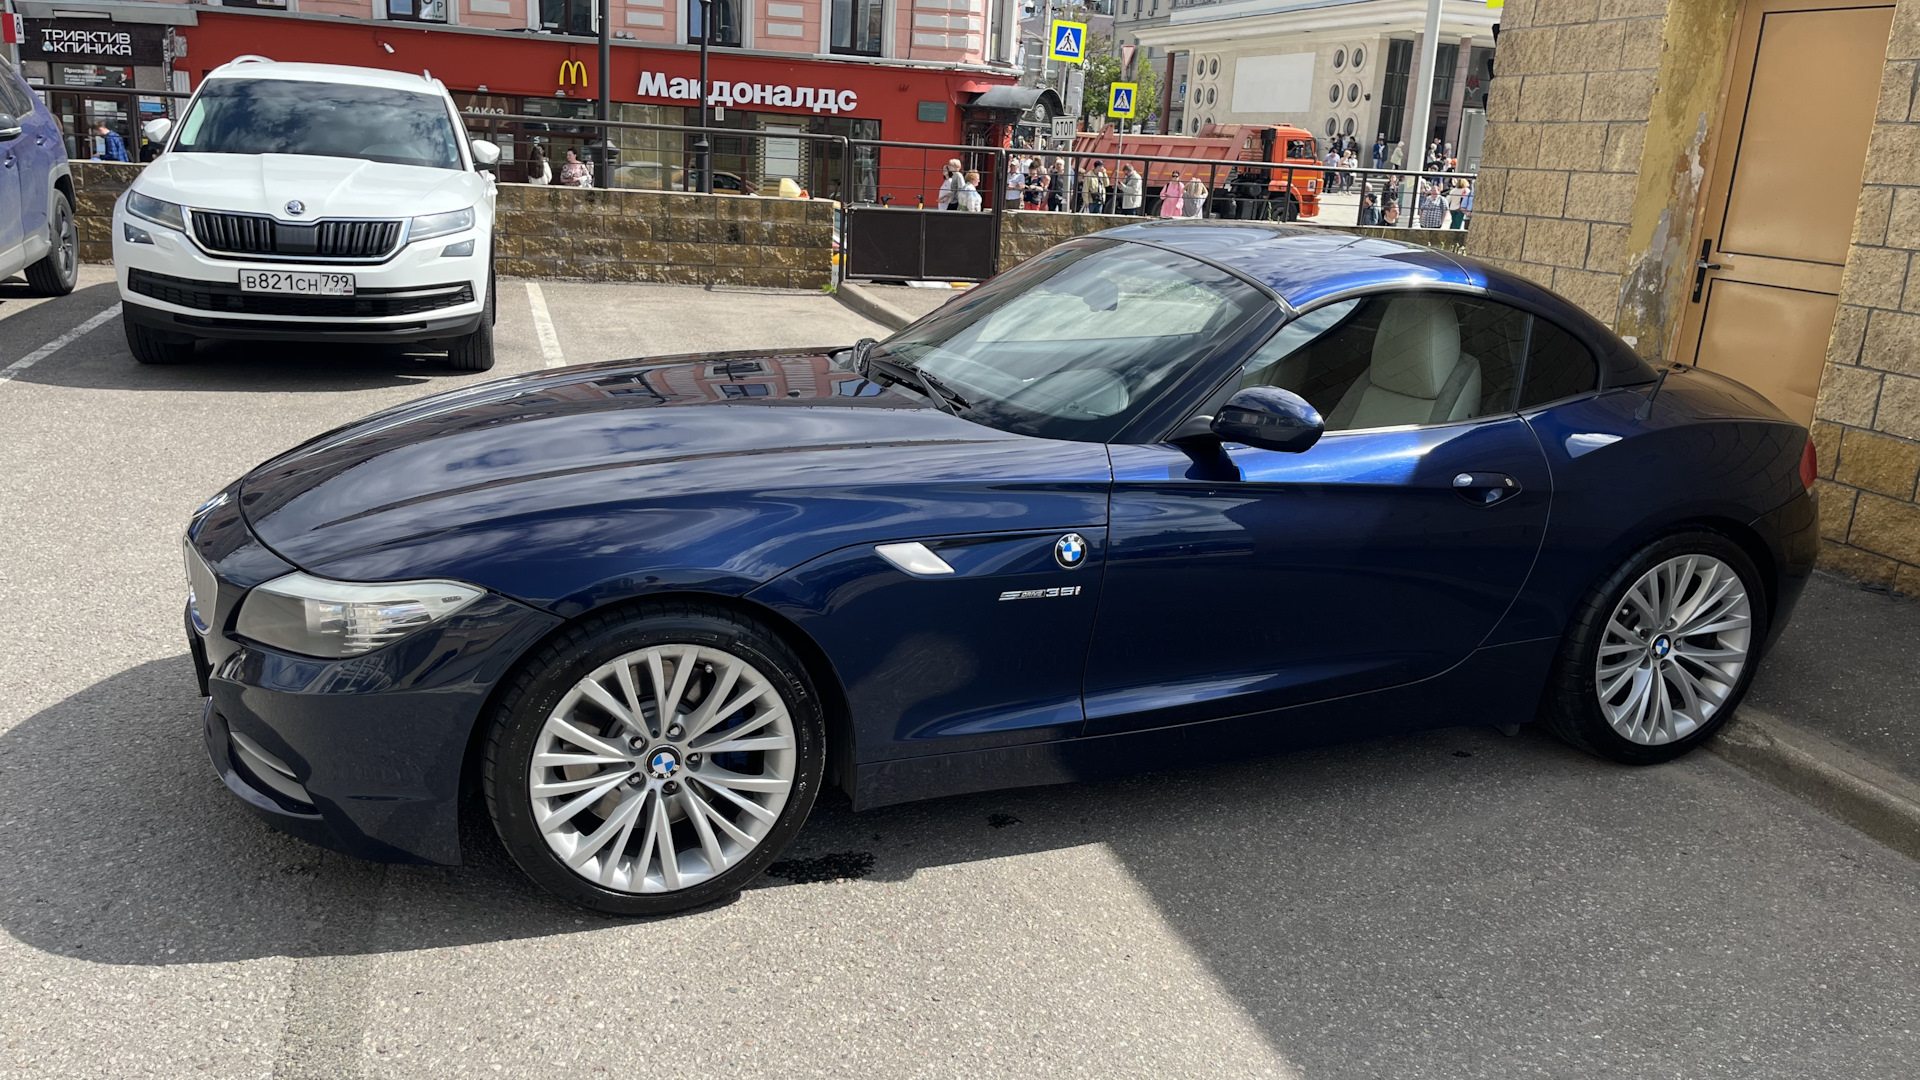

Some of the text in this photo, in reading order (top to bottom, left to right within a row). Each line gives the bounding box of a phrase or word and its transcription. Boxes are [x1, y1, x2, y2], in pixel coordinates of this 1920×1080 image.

[41, 29, 131, 44] ТРИАКТИВ
[53, 41, 132, 56] КЛИНИКА
[637, 71, 858, 114] Макдоналдс
[465, 106, 505, 116] ЗАКАЗ
[1055, 121, 1074, 136] СТОП
[322, 275, 349, 287] 799
